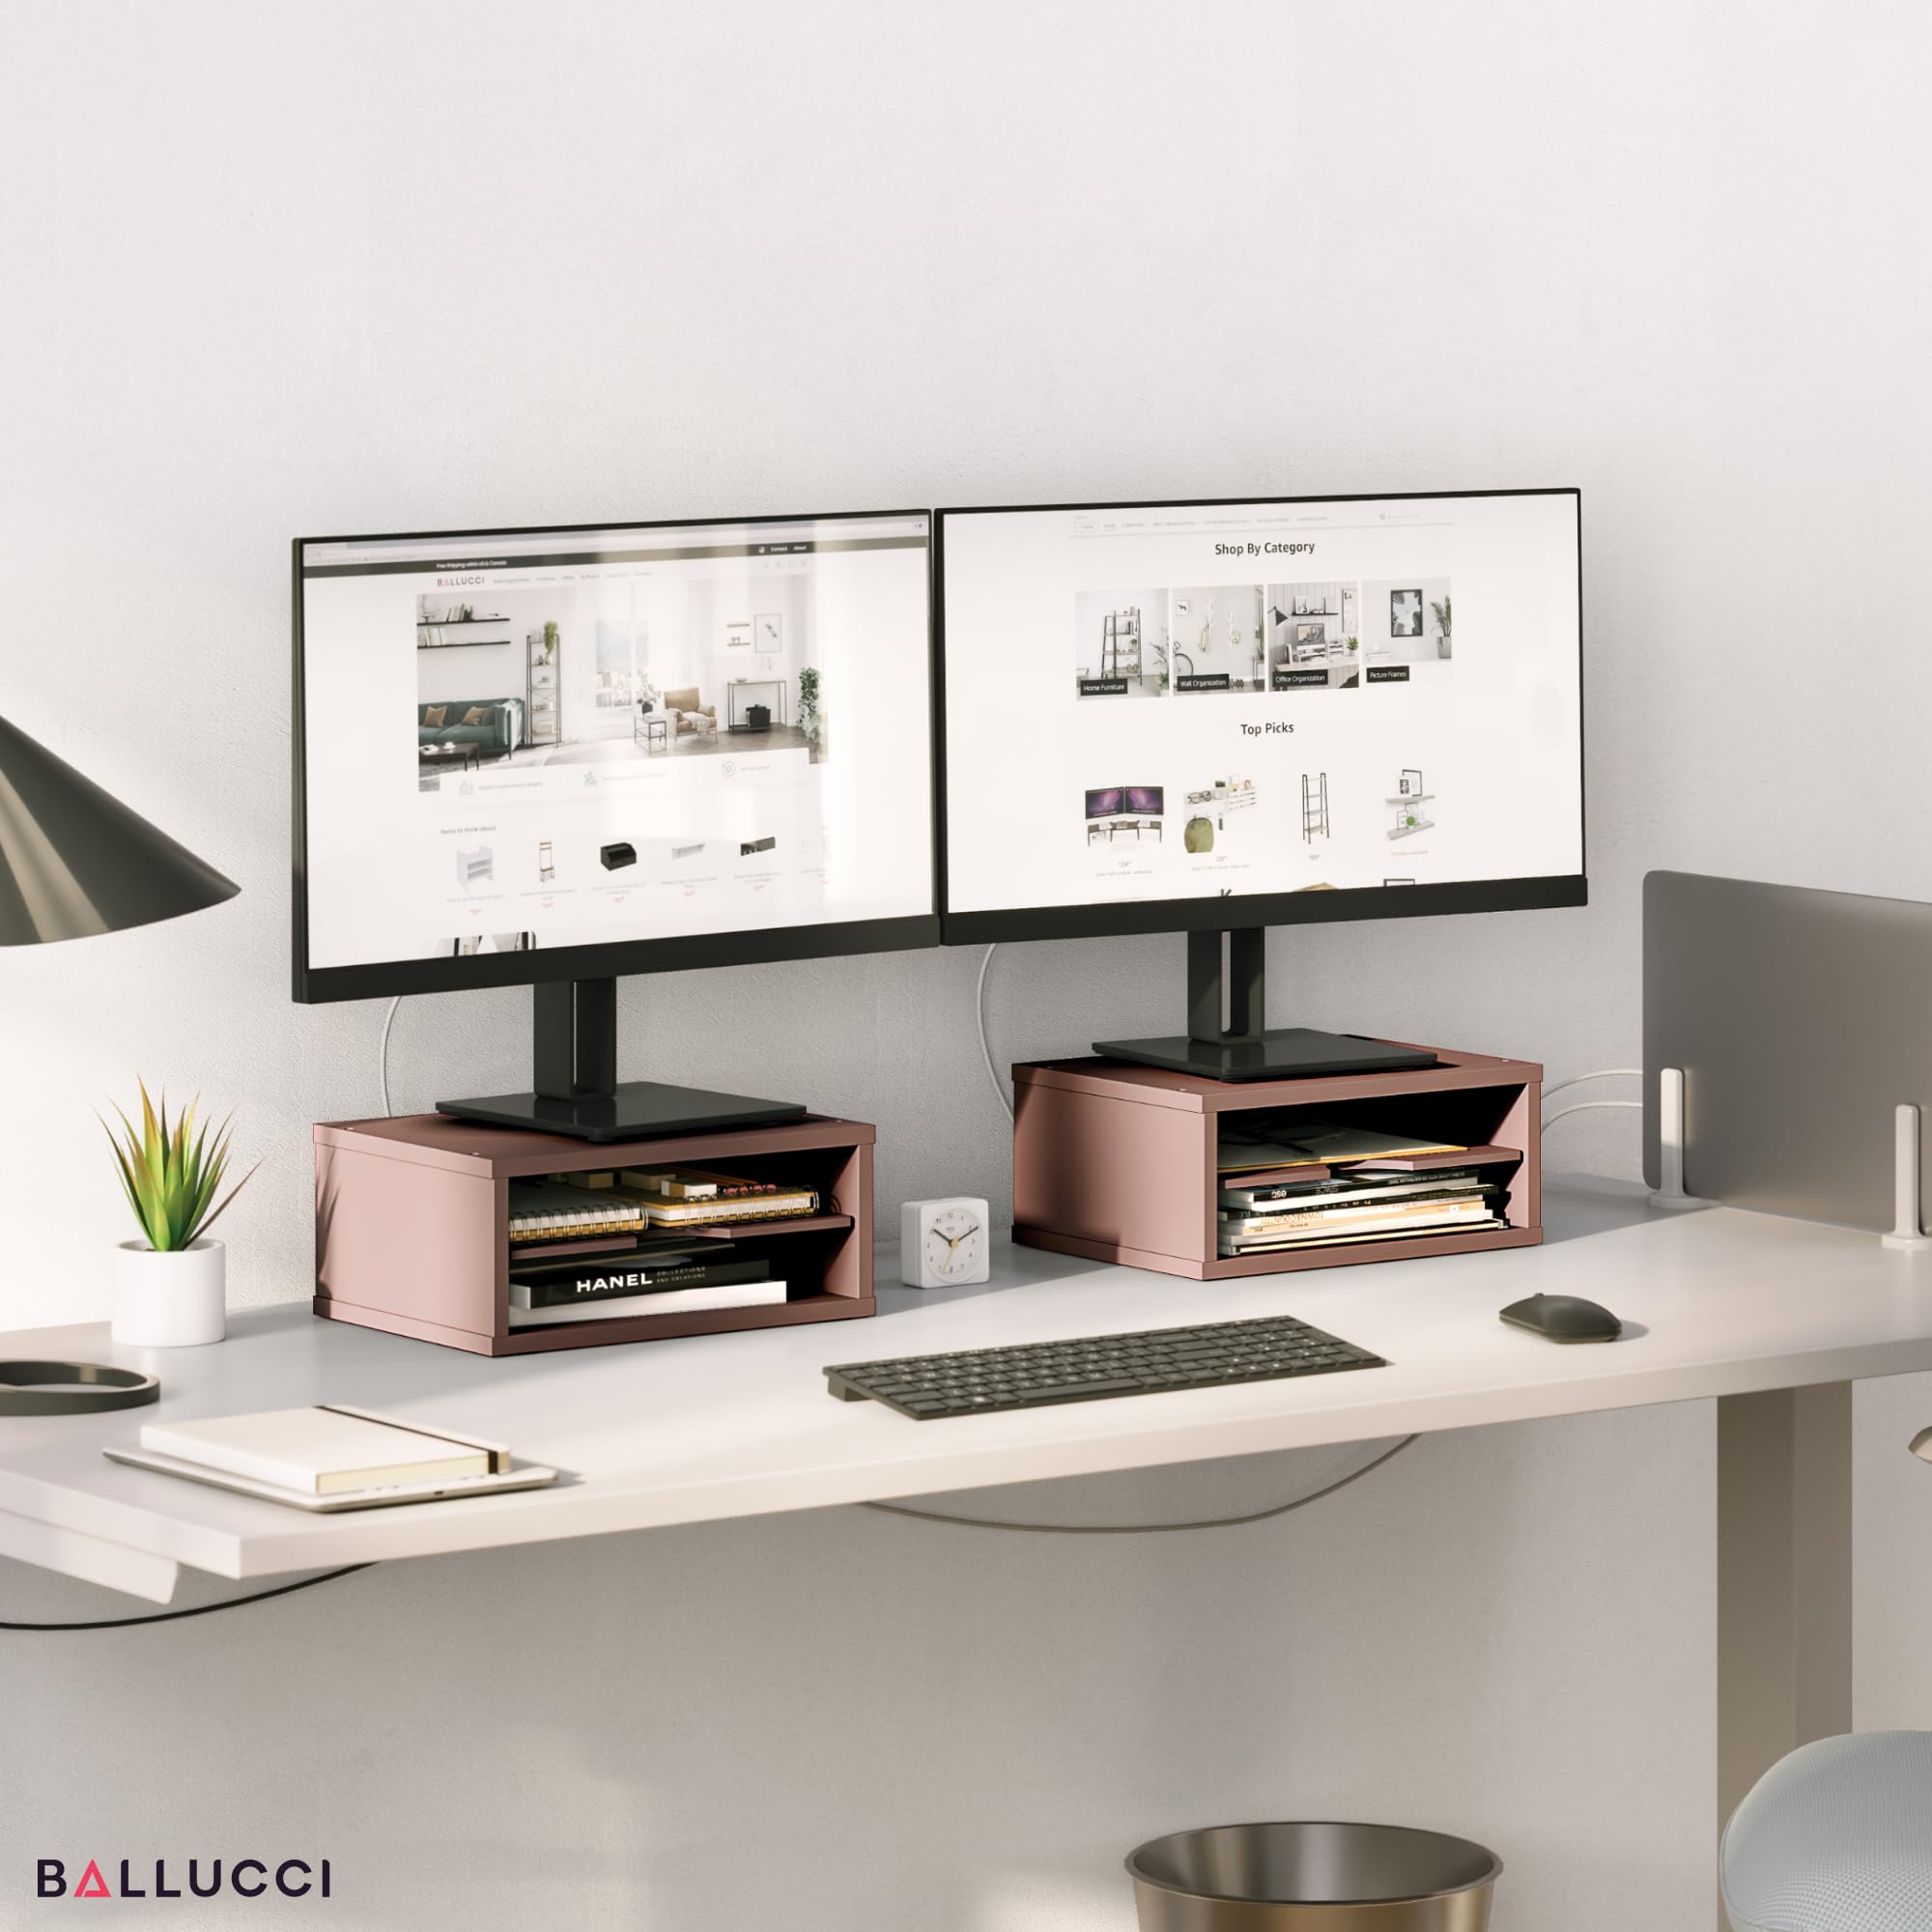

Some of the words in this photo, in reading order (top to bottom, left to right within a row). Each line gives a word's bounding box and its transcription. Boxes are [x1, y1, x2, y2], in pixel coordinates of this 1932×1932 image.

[1214, 543, 1244, 556] Shop
[1247, 542, 1262, 556] By
[1264, 540, 1316, 555] Category
[437, 577, 485, 587] BALLUCCI
[1192, 678, 1227, 688] Organization
[1292, 674, 1325, 683] Organization
[1100, 683, 1125, 692] Furniture
[1240, 724, 1262, 737] Top
[1264, 722, 1294, 734] Picks
[576, 1272, 653, 1293] HANEL
